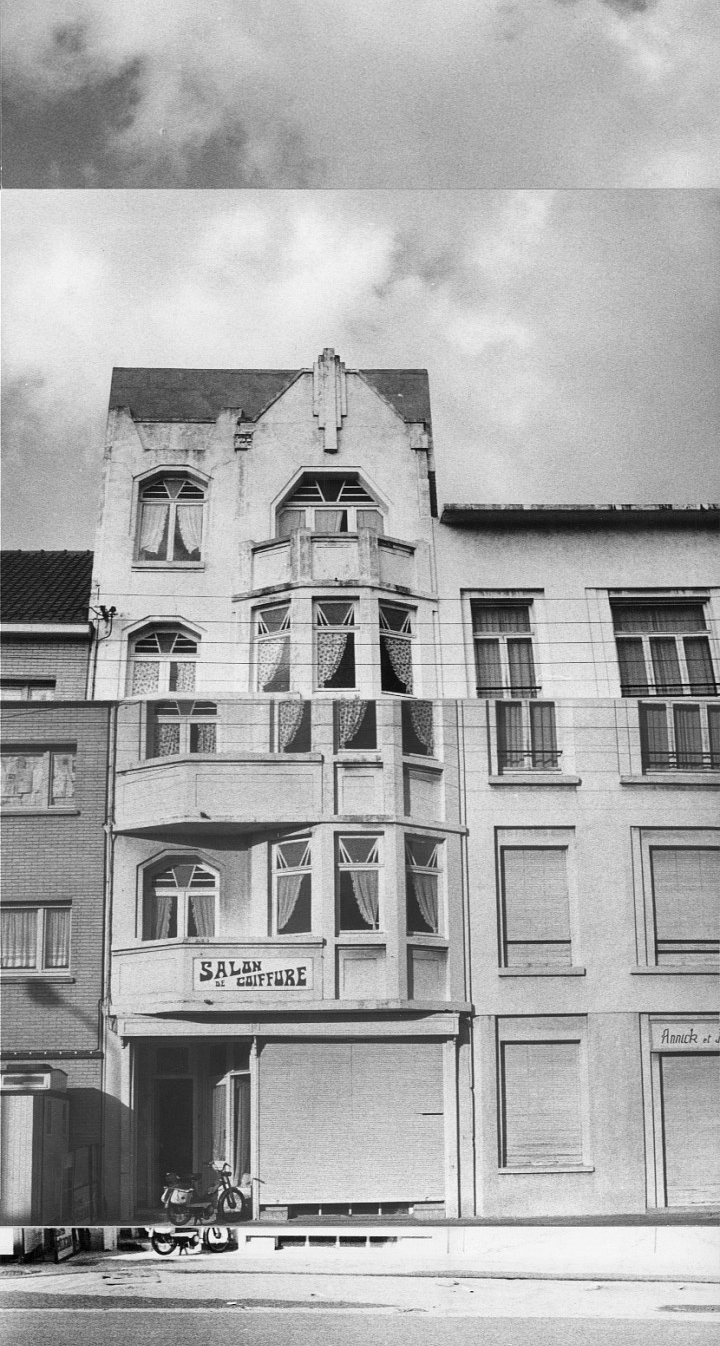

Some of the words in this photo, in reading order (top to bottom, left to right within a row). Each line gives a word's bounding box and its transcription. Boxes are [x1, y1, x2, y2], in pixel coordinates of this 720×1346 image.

[200, 961, 261, 982] SALON
[215, 979, 225, 987] DE
[236, 966, 307, 987] COIFFURE
[661, 1028, 698, 1044] Annick
[702, 1034, 712, 1044] et
